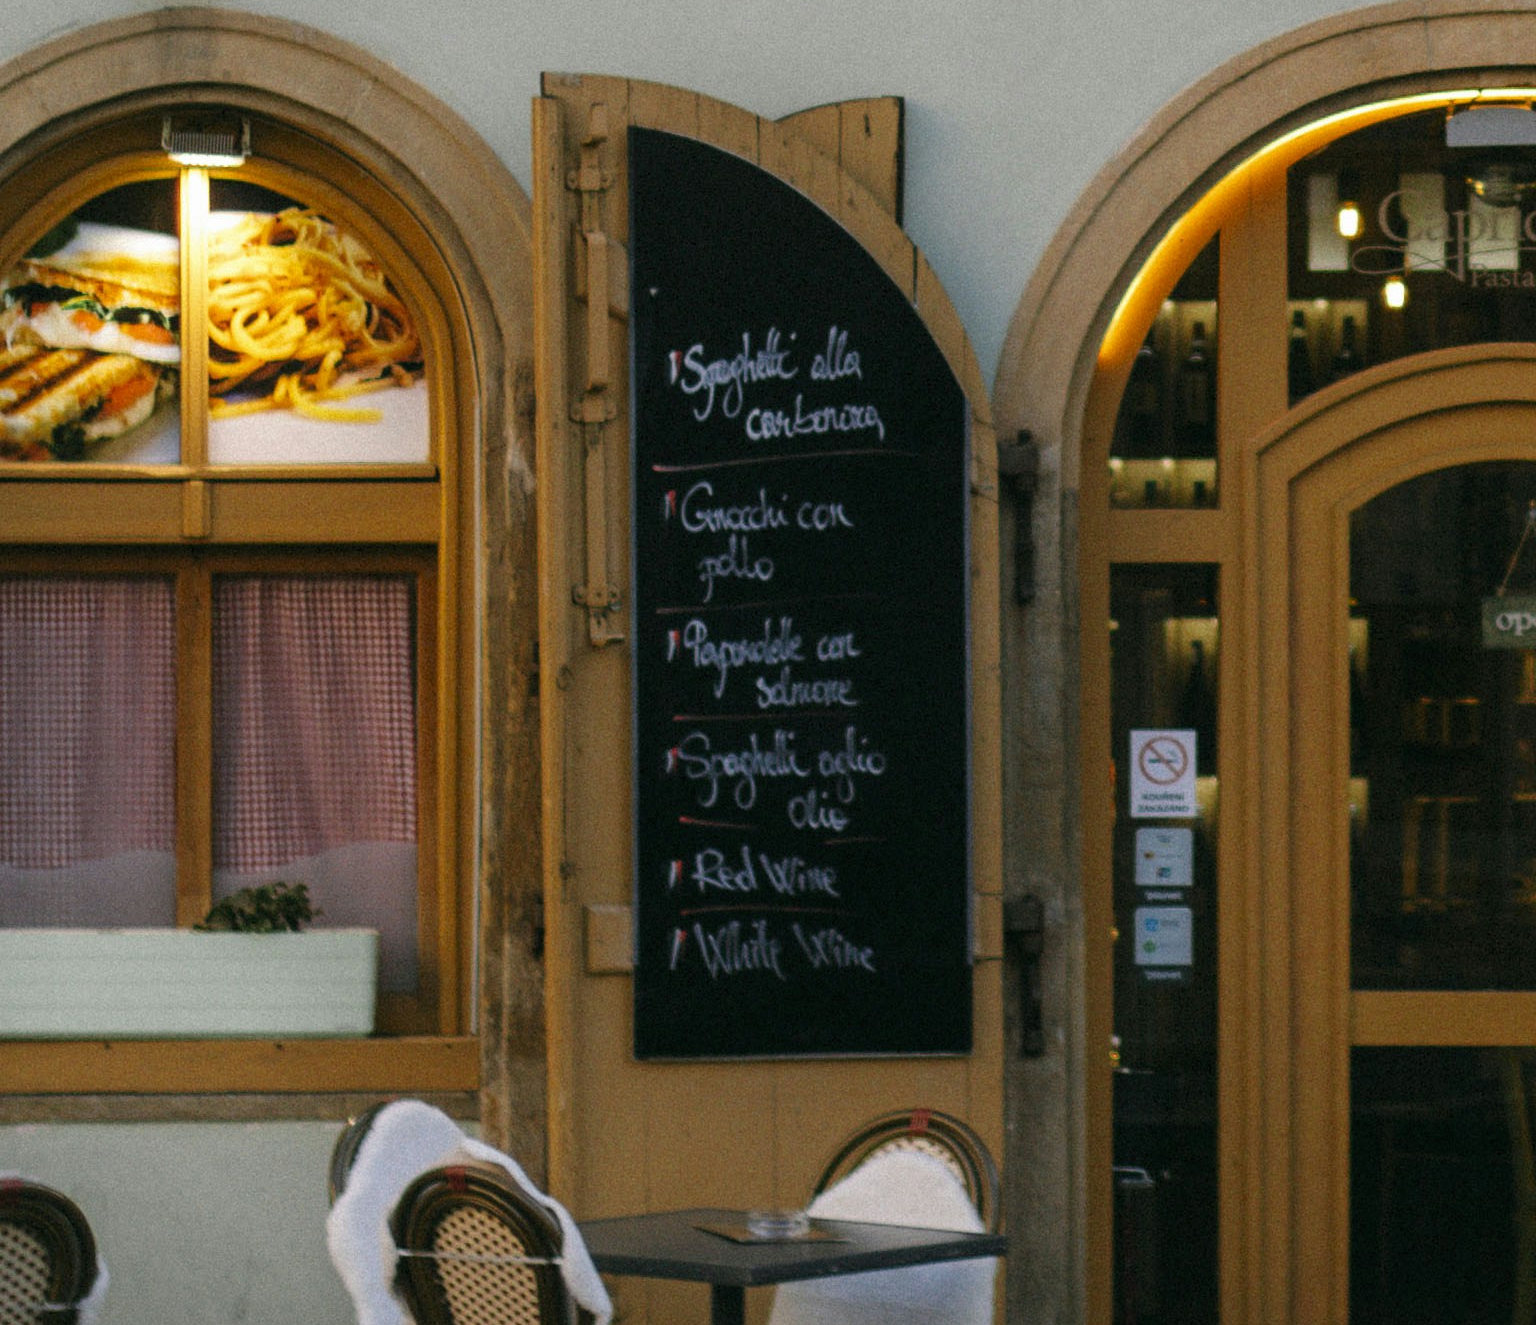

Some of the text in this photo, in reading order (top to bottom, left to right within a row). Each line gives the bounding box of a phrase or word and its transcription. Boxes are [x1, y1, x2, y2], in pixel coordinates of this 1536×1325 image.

[1470, 263, 1534, 288] Pasta
[680, 325, 862, 422] Spaghetti alla
[798, 500, 854, 531] con
[816, 632, 861, 661] con
[679, 726, 885, 810] Spaghetti aglio
[692, 845, 841, 897] Red Wine
[792, 923, 876, 972] Wine
